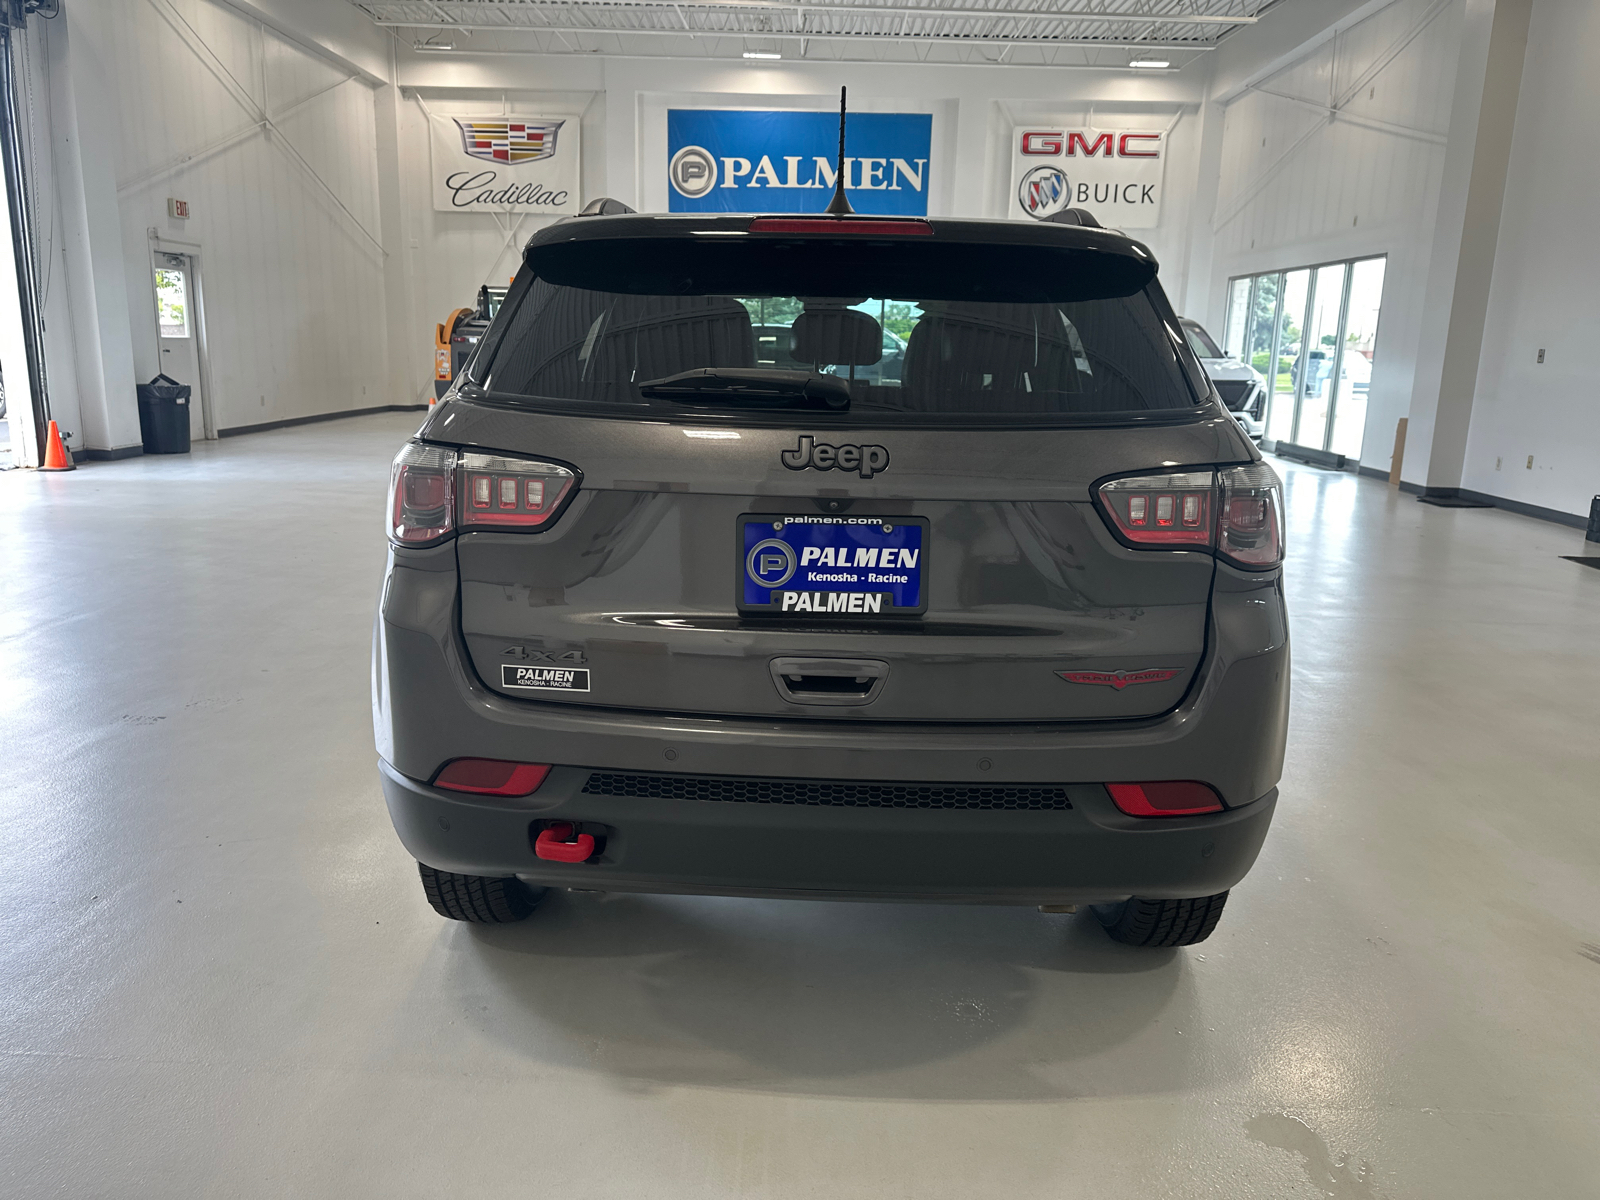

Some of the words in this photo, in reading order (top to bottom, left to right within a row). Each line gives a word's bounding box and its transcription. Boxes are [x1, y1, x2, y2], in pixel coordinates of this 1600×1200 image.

[1020, 130, 1161, 159] GMC
[720, 155, 927, 192] PALMEN
[445, 170, 568, 207] Cadillac
[1076, 182, 1155, 204] BUICK
[175, 200, 187, 217] EXIT
[781, 435, 890, 479] Jeep
[784, 515, 883, 525] palmen.com
[800, 546, 919, 569] PALMEN
[807, 572, 858, 583] Kenosha
[868, 573, 908, 584] Racine
[781, 591, 882, 613] PALMEN
[517, 668, 575, 682] PALMEN
